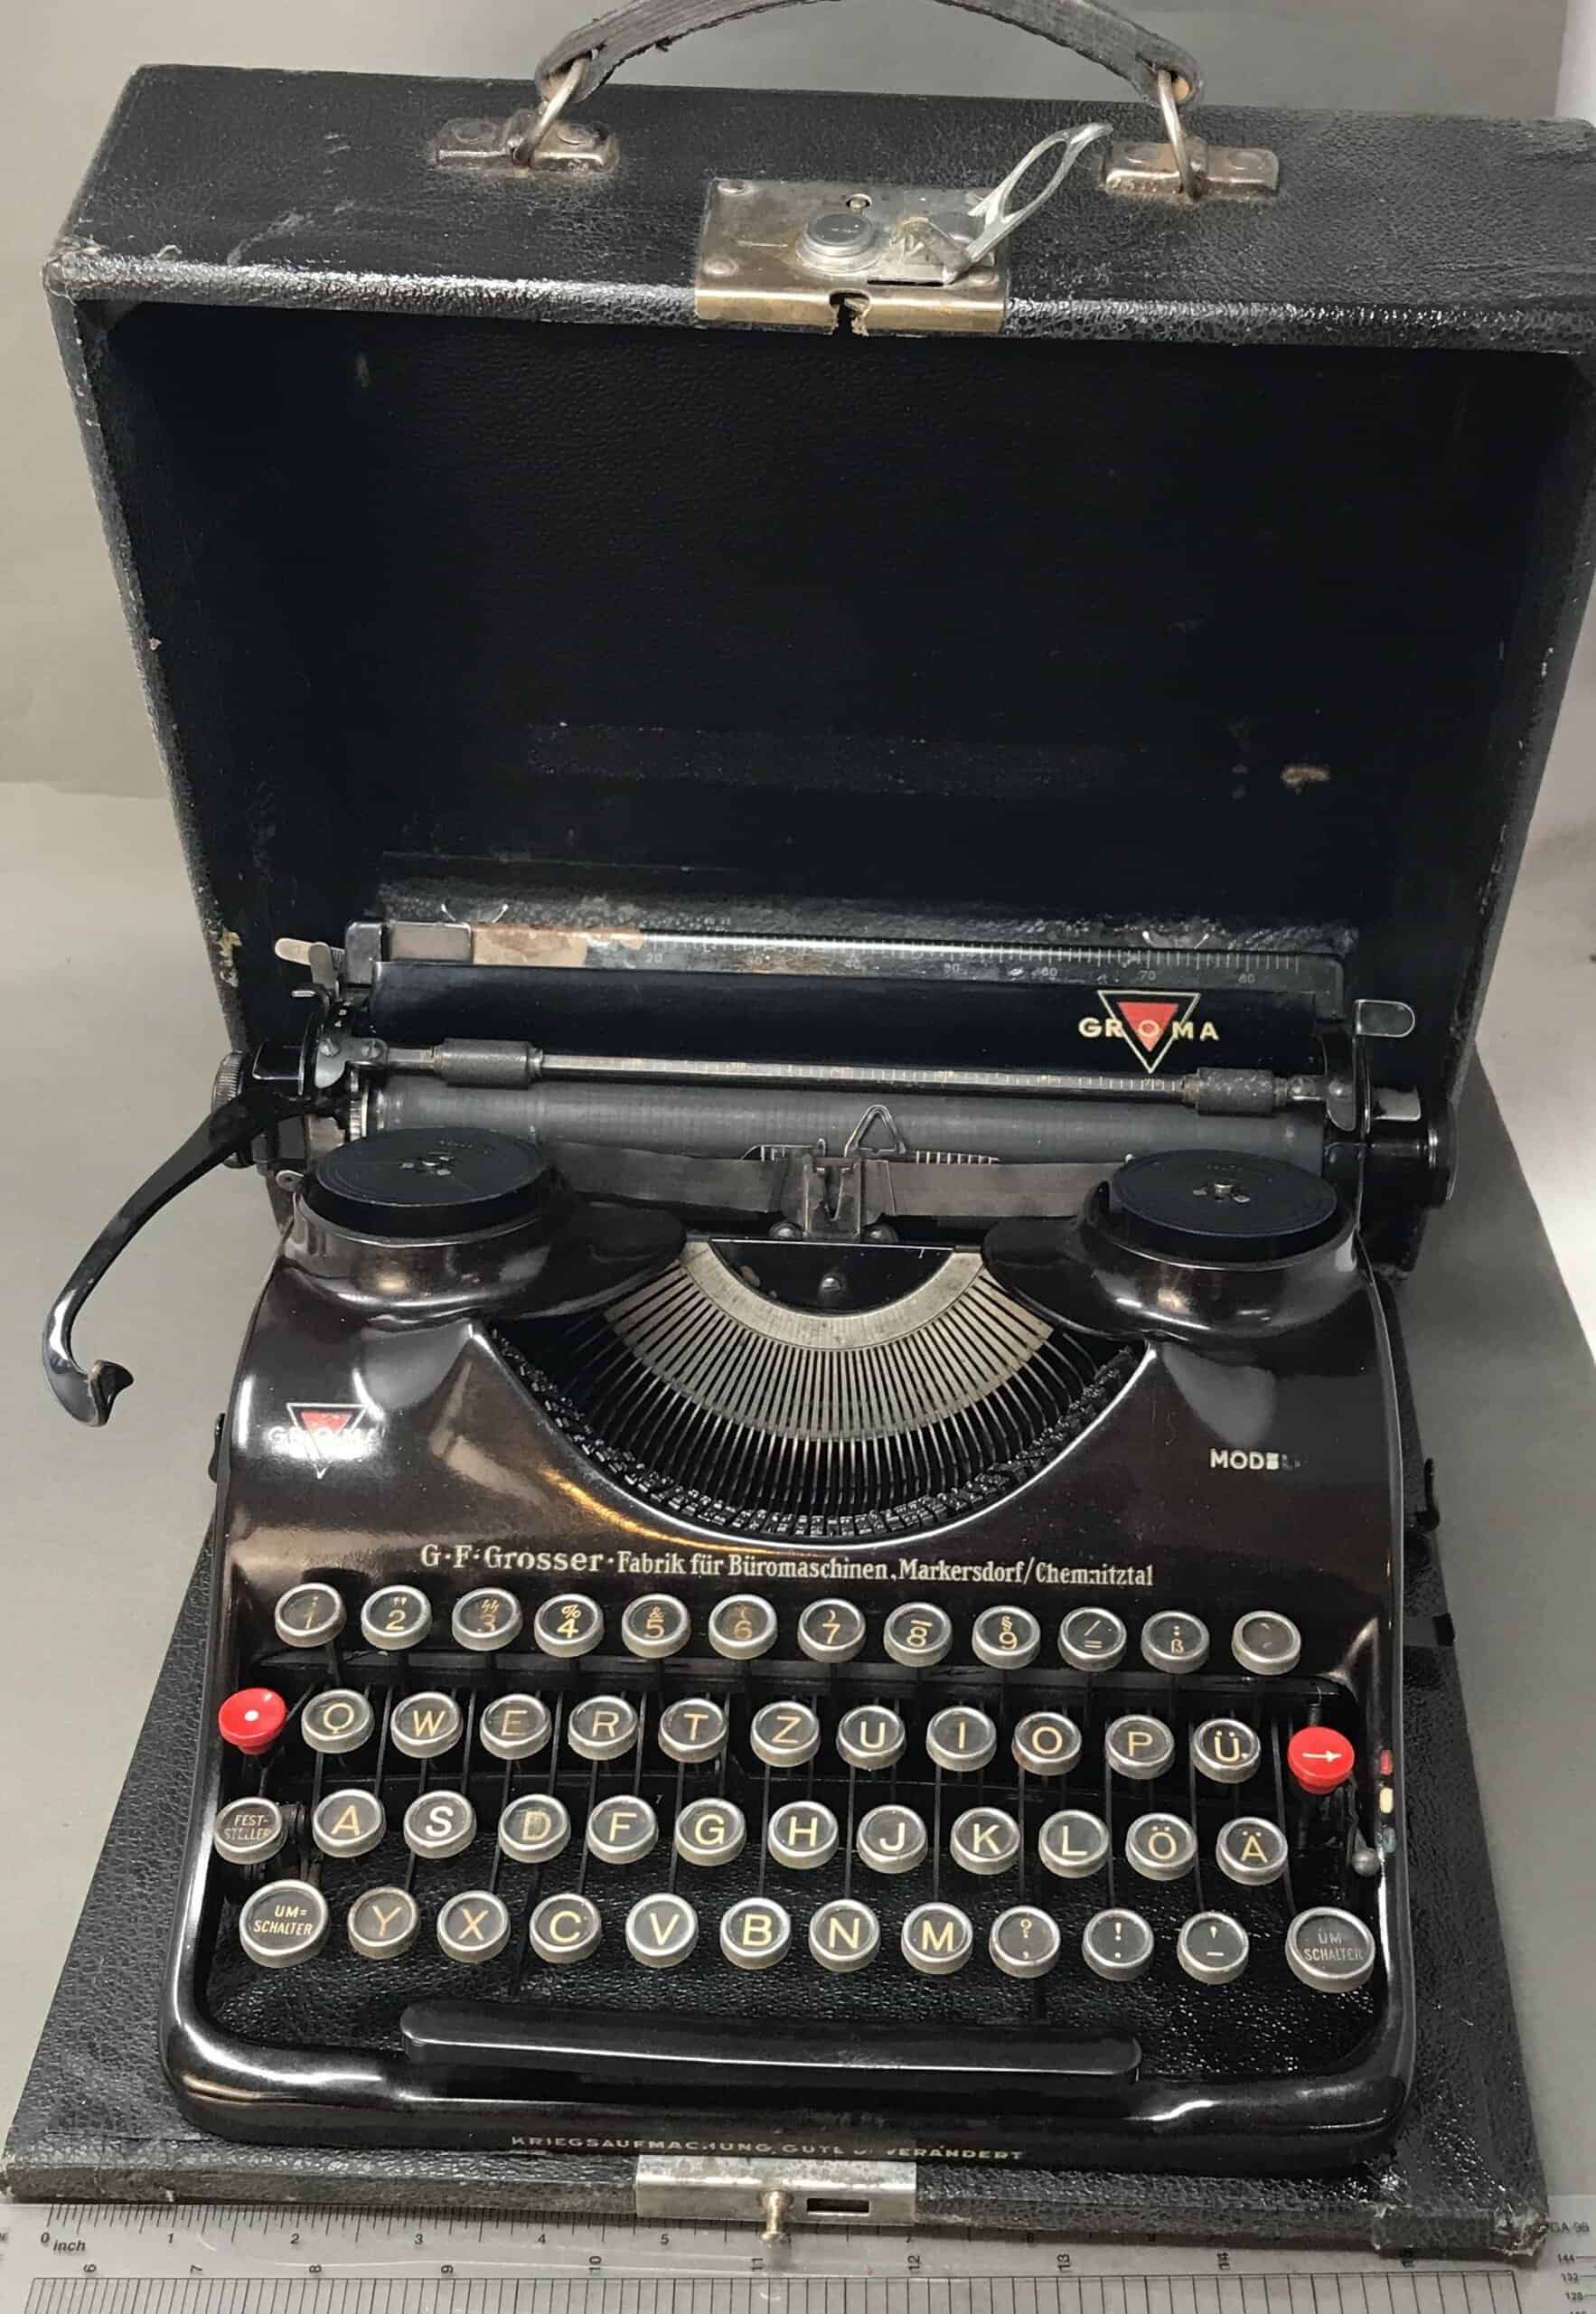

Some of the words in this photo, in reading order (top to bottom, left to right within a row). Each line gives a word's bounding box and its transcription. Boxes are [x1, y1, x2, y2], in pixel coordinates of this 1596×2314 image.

[1139, 970, 1157, 981] 70
[1078, 1017, 1219, 1040] GROMA
[690, 1551, 723, 1576] für
[386, 1610, 406, 1632] 2
[560, 1604, 582, 1618] %
[649, 1606, 665, 1619] &
[481, 1614, 497, 1632] 3
[557, 1619, 579, 1638] 4
[644, 1620, 665, 1639] 5
[734, 1620, 753, 1639] 6
[822, 1623, 840, 1644] 7
[1001, 1615, 1012, 1631] §
[906, 1627, 927, 1648] 8
[999, 1631, 1018, 1650] 9
[323, 1703, 354, 1734] Q
[413, 1709, 446, 1736] W
[501, 1709, 528, 1736] E
[591, 1711, 620, 1737] R
[684, 1713, 709, 1741] T
[771, 1716, 802, 1744] Z
[860, 1721, 886, 1749] U
[958, 1721, 966, 1750] I
[1031, 1726, 1063, 1754] O
[1128, 1731, 1153, 1756] P
[1214, 1731, 1242, 1762] Ü
[234, 1814, 268, 1827] FEST-
[331, 1805, 361, 1836] A
[425, 1806, 454, 1838] S
[521, 1811, 551, 1841] D
[608, 1811, 637, 1842] F
[694, 1814, 725, 1846] G
[787, 1816, 818, 1847] H
[879, 1821, 906, 1851] J
[972, 1823, 1000, 1854] K
[1061, 1825, 1087, 1856] L
[1148, 1825, 1177, 1860] Ö
[1240, 1830, 1269, 1863] Ä
[253, 1919, 313, 1936] SCHALTER
[372, 1905, 402, 1937] Y
[458, 1908, 490, 1941] X
[549, 1910, 581, 1942] C
[649, 1913, 680, 1946] V
[742, 1914, 773, 1946] B
[1019, 1919, 1032, 1939] ?
[1114, 1922, 1122, 1942] !
[828, 1917, 860, 1949] N
[922, 1920, 955, 1952] M
[41, 2232, 51, 2243] 0
[53, 2240, 86, 2253] inch
[167, 2233, 174, 2243] 1
[290, 2234, 300, 2244] 2
[415, 2234, 423, 2244] 3
[538, 2234, 546, 2243] 4
[661, 2234, 669, 2245] 5
[83, 2263, 97, 2273] 6
[190, 2264, 202, 2274] 7
[309, 2264, 322, 2273] 8
[441, 2264, 454, 2274] 9
[589, 2255, 602, 2272] 10
[751, 2257, 763, 2272] 11
[907, 2255, 920, 2271] 12
[1057, 2253, 1070, 2271] 13
